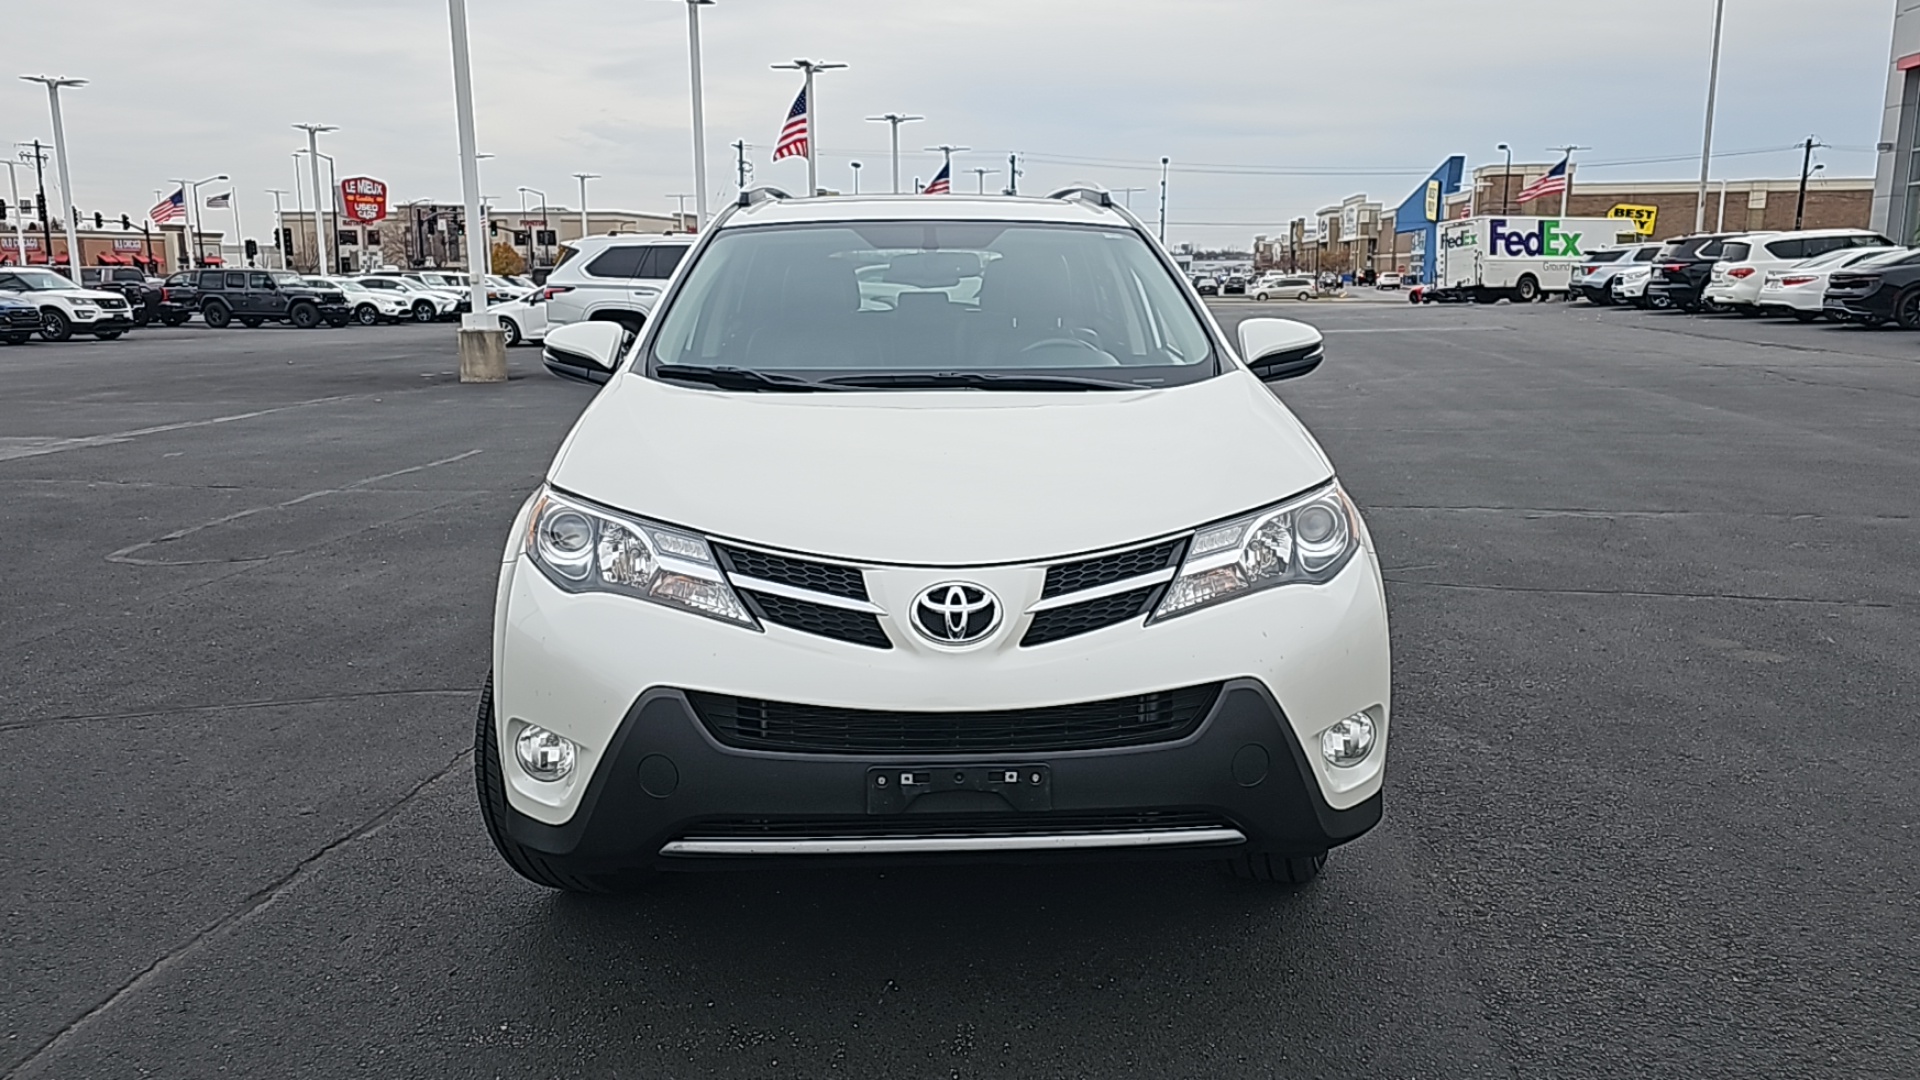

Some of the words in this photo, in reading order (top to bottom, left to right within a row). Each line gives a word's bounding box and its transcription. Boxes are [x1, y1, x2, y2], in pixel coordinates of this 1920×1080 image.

[345, 181, 356, 193] LE
[357, 179, 383, 195] MIEUX
[354, 203, 379, 212] USED
[357, 211, 377, 219] CARS
[1614, 208, 1655, 219] BEST
[1440, 229, 1478, 250] FedEx
[1489, 219, 1583, 257] FedEx
[1543, 261, 1570, 271] Ground
